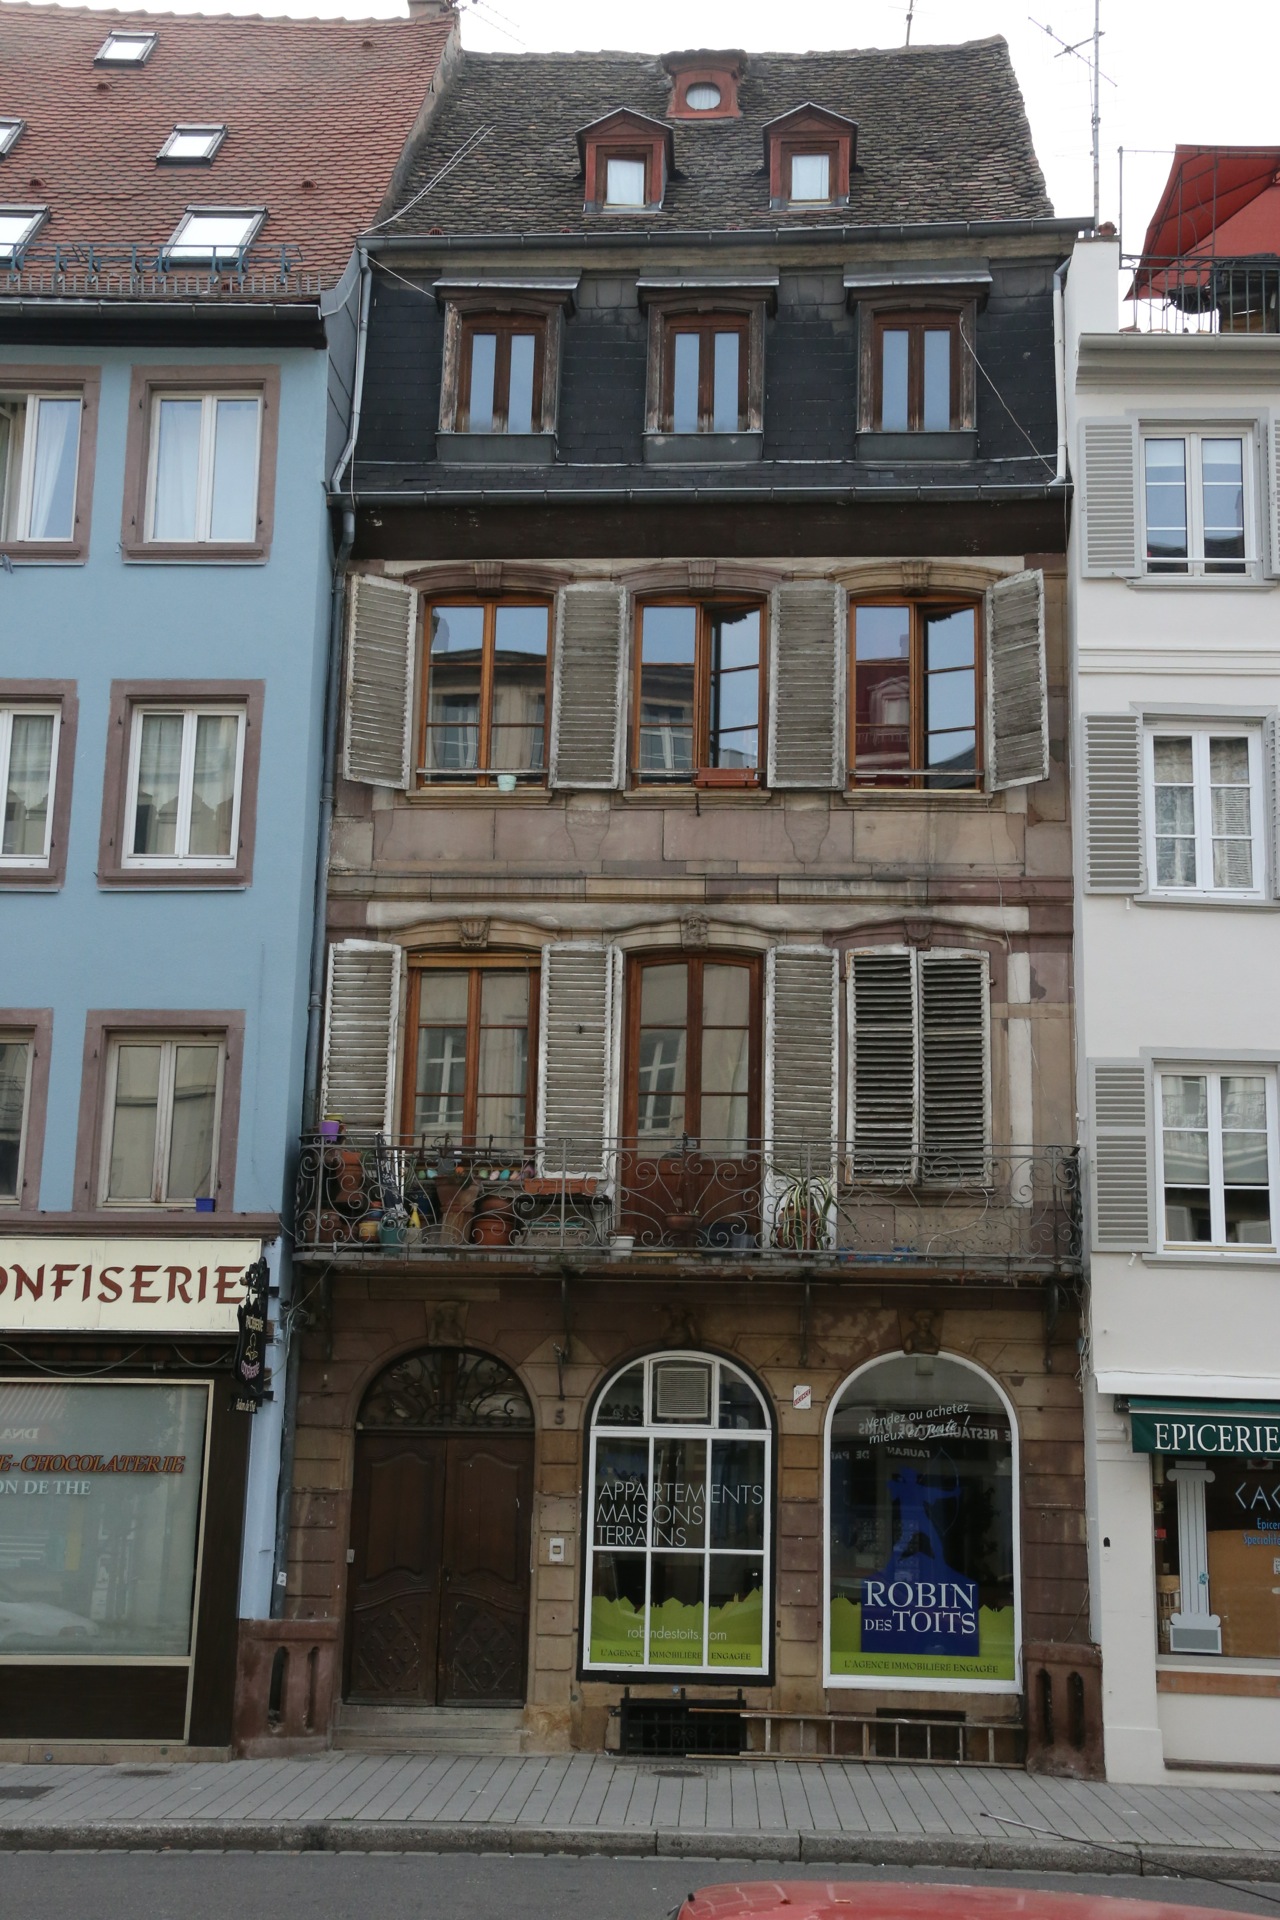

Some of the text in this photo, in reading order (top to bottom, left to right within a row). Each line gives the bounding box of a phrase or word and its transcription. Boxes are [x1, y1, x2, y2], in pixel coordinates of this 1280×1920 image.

[0, 1263, 247, 1304] NFISERIE
[866, 1403, 969, 1428] Vendez ou achetez
[869, 1430, 905, 1444] mieux
[1154, 1422, 1280, 1453] EPICERIE
[0, 1480, 91, 1495] N DE THE
[598, 1481, 763, 1505] APPARTEMENTS
[596, 1503, 703, 1525] MAISONS
[596, 1525, 687, 1547] TERRAINS
[864, 1580, 976, 1609] ROBIN
[627, 1625, 727, 1641] robndestoits.om
[864, 1610, 976, 1635] DES TOITS
[600, 1649, 641, 1658] L'AGENCE
[844, 1660, 890, 1670] L'AGENCE
